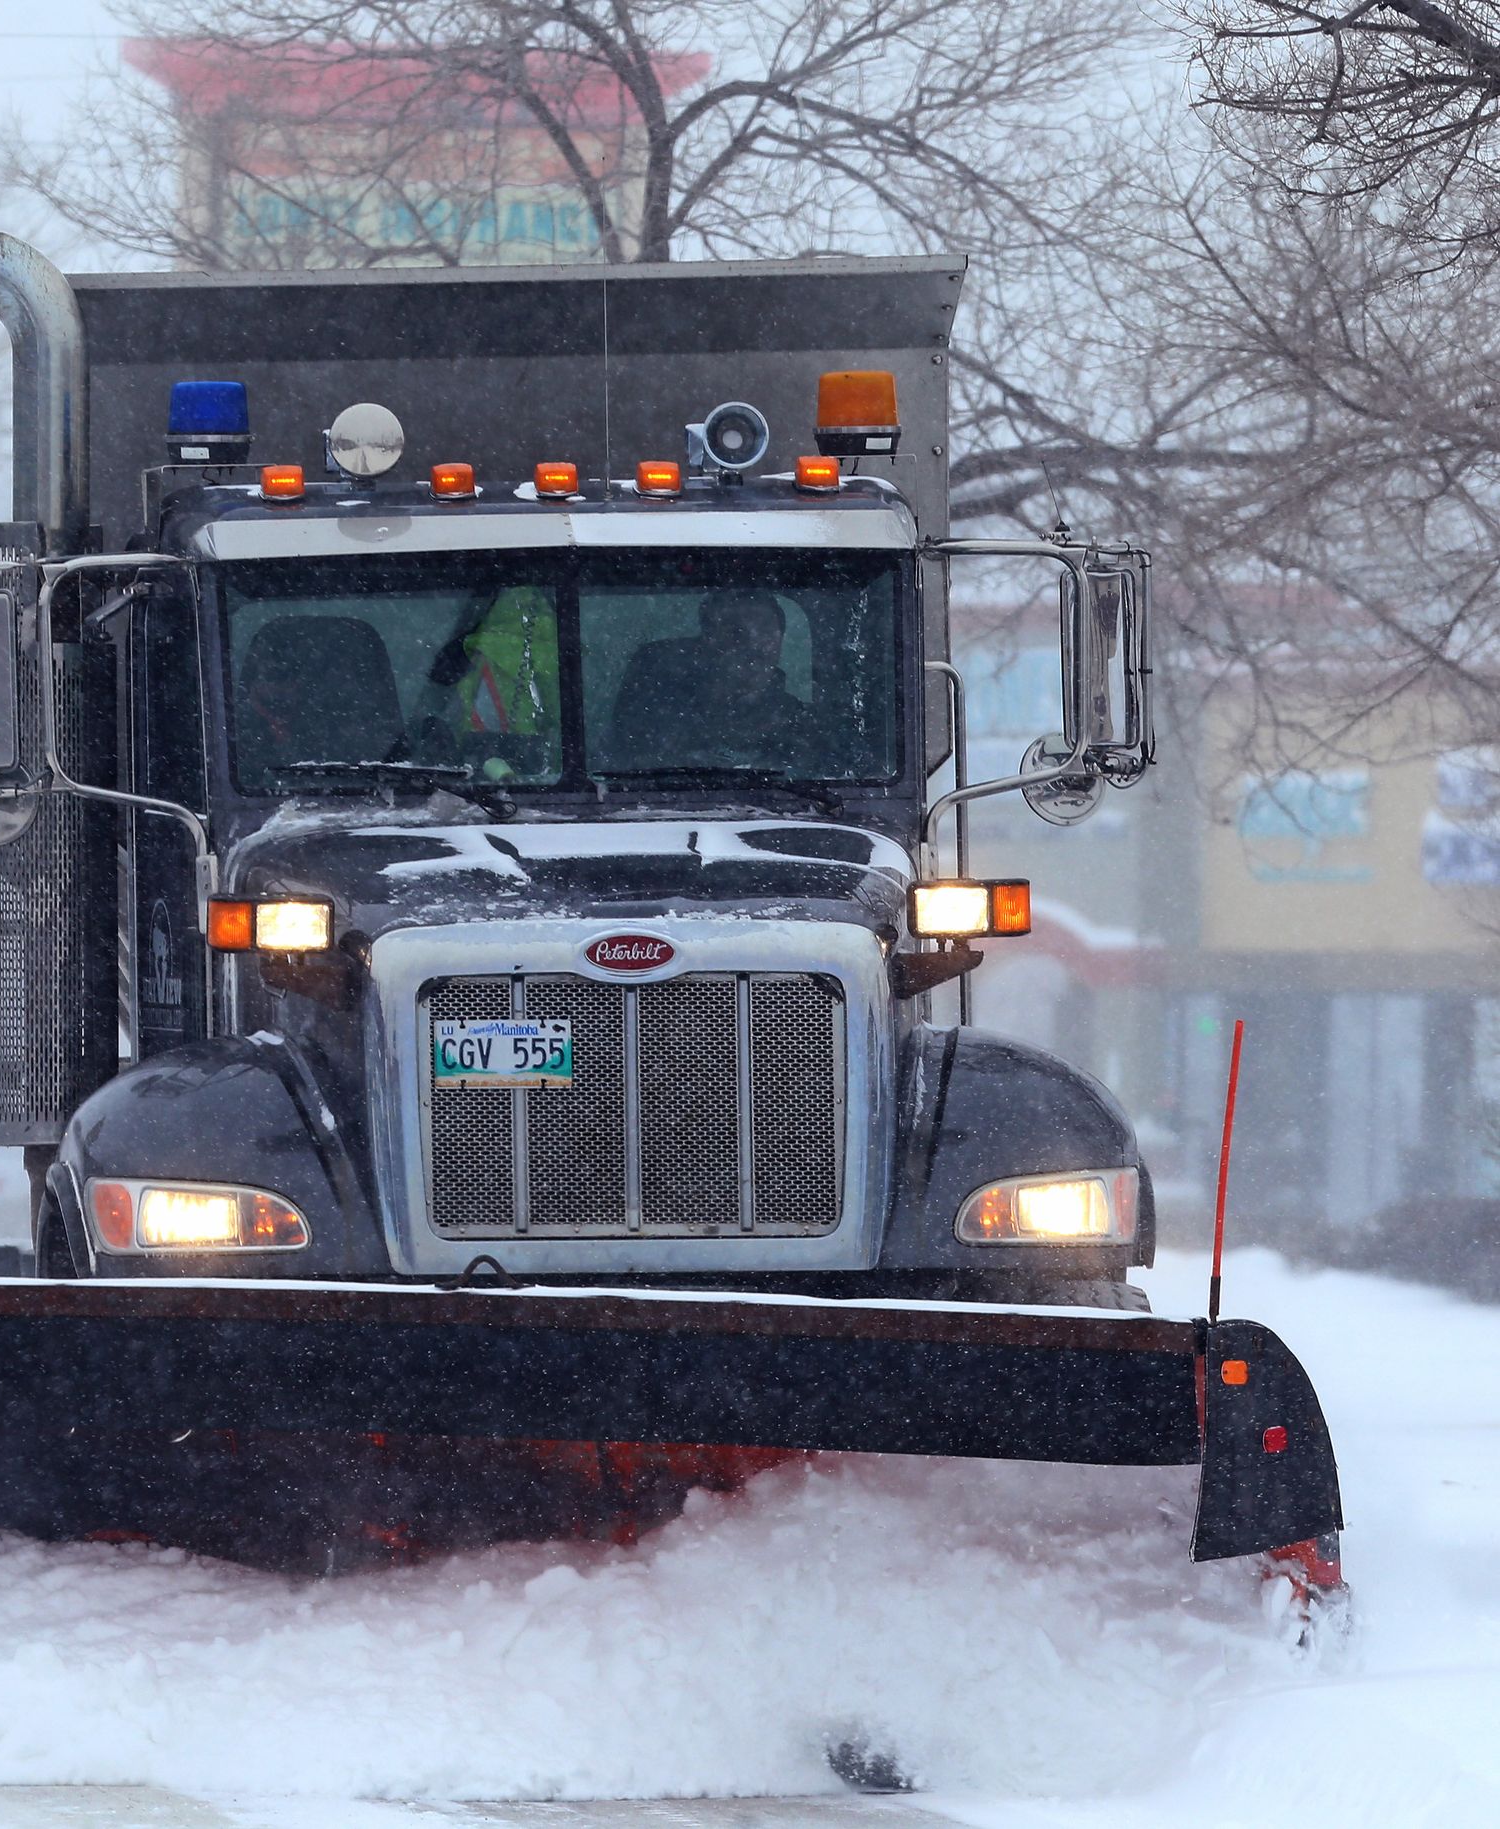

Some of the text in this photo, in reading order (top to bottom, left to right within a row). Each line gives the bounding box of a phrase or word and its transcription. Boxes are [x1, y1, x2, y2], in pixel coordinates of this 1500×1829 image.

[596, 941, 667, 962] Peterbilt
[442, 1026, 453, 1036] LU
[497, 1023, 539, 1036] Manitoba
[442, 1038, 565, 1070] CGV 555
